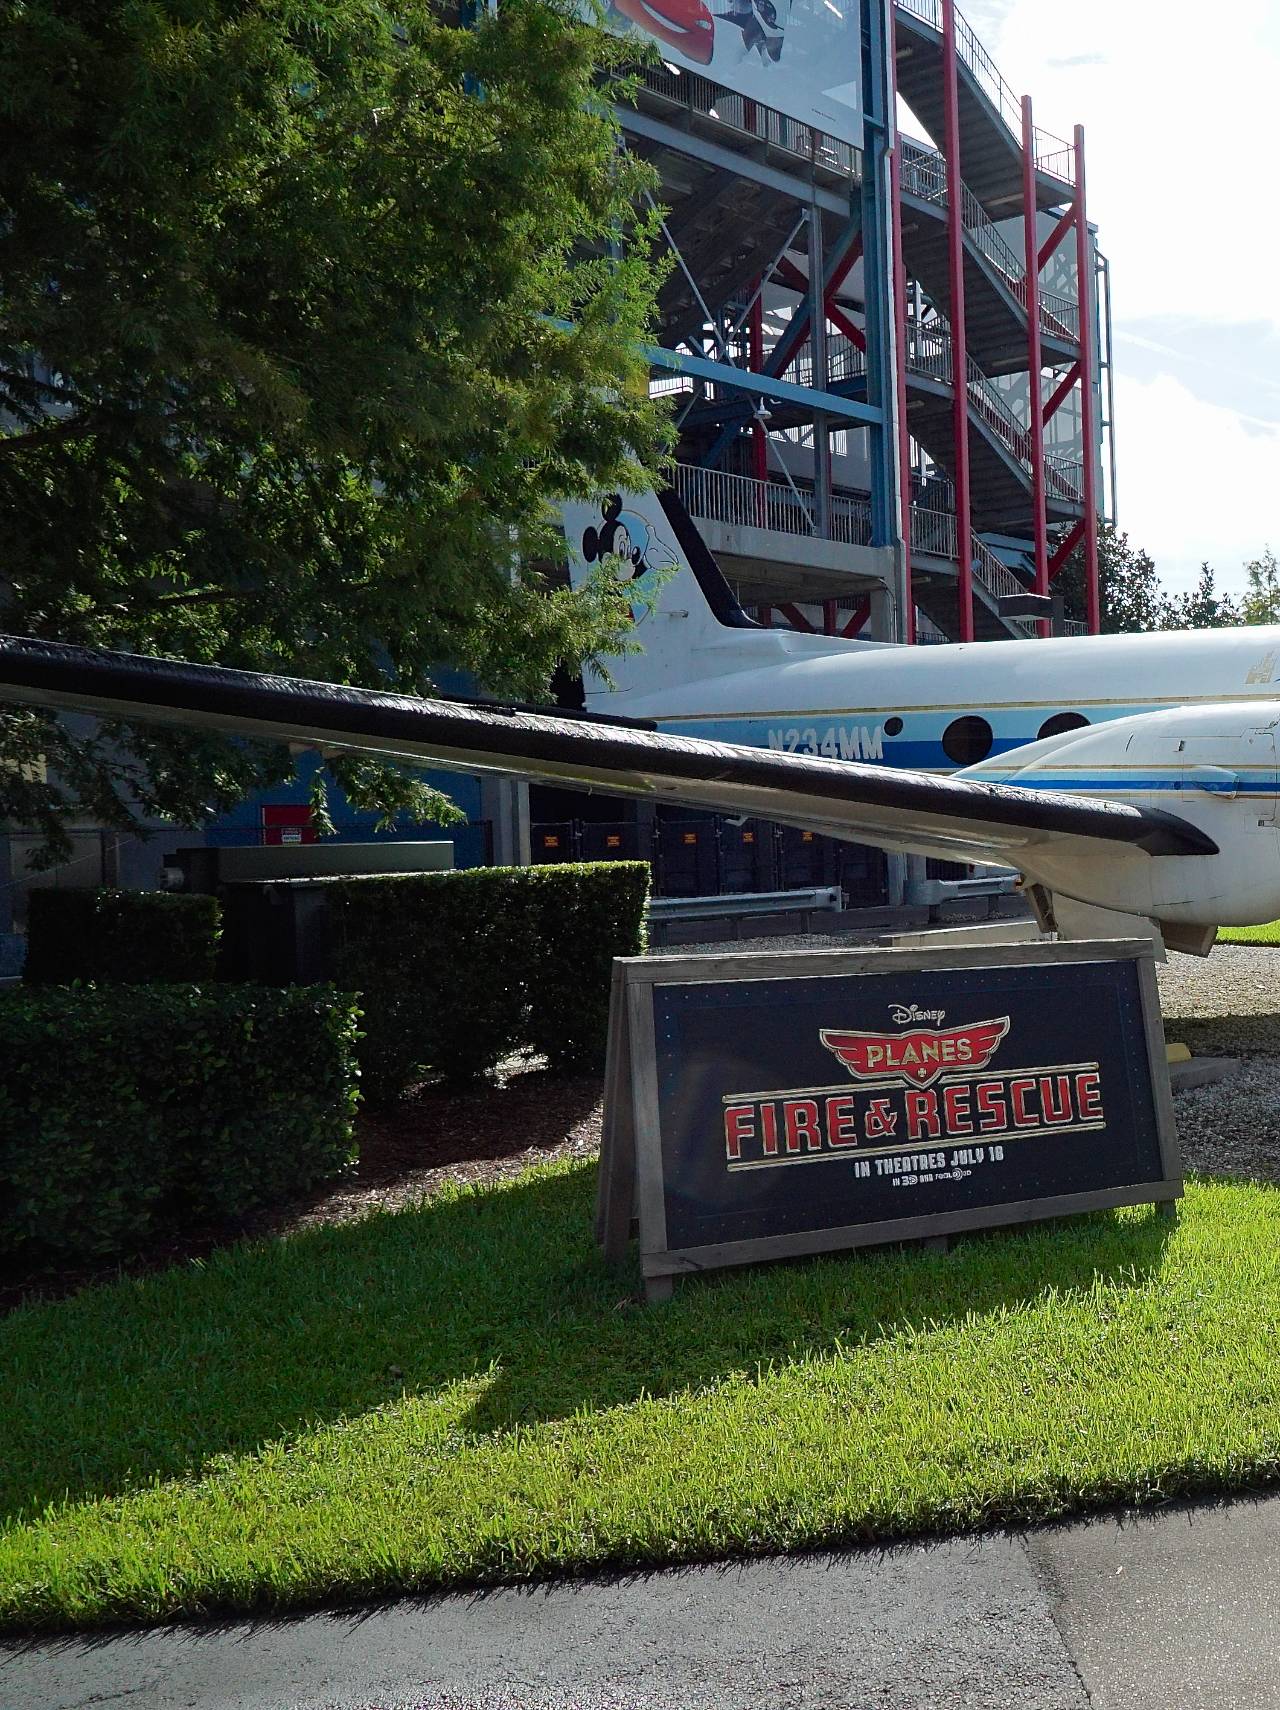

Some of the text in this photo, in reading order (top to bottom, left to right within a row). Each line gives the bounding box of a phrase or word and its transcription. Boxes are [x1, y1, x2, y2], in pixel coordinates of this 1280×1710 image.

[767, 725, 885, 760] N234MM
[887, 1004, 946, 1027] Disney
[866, 1038, 972, 1068] PLANES
[724, 1072, 1104, 1159] FIRE & RESCUE
[854, 1160, 871, 1178] IN
[874, 1152, 946, 1176] THEATRES
[950, 1147, 985, 1167] JULY
